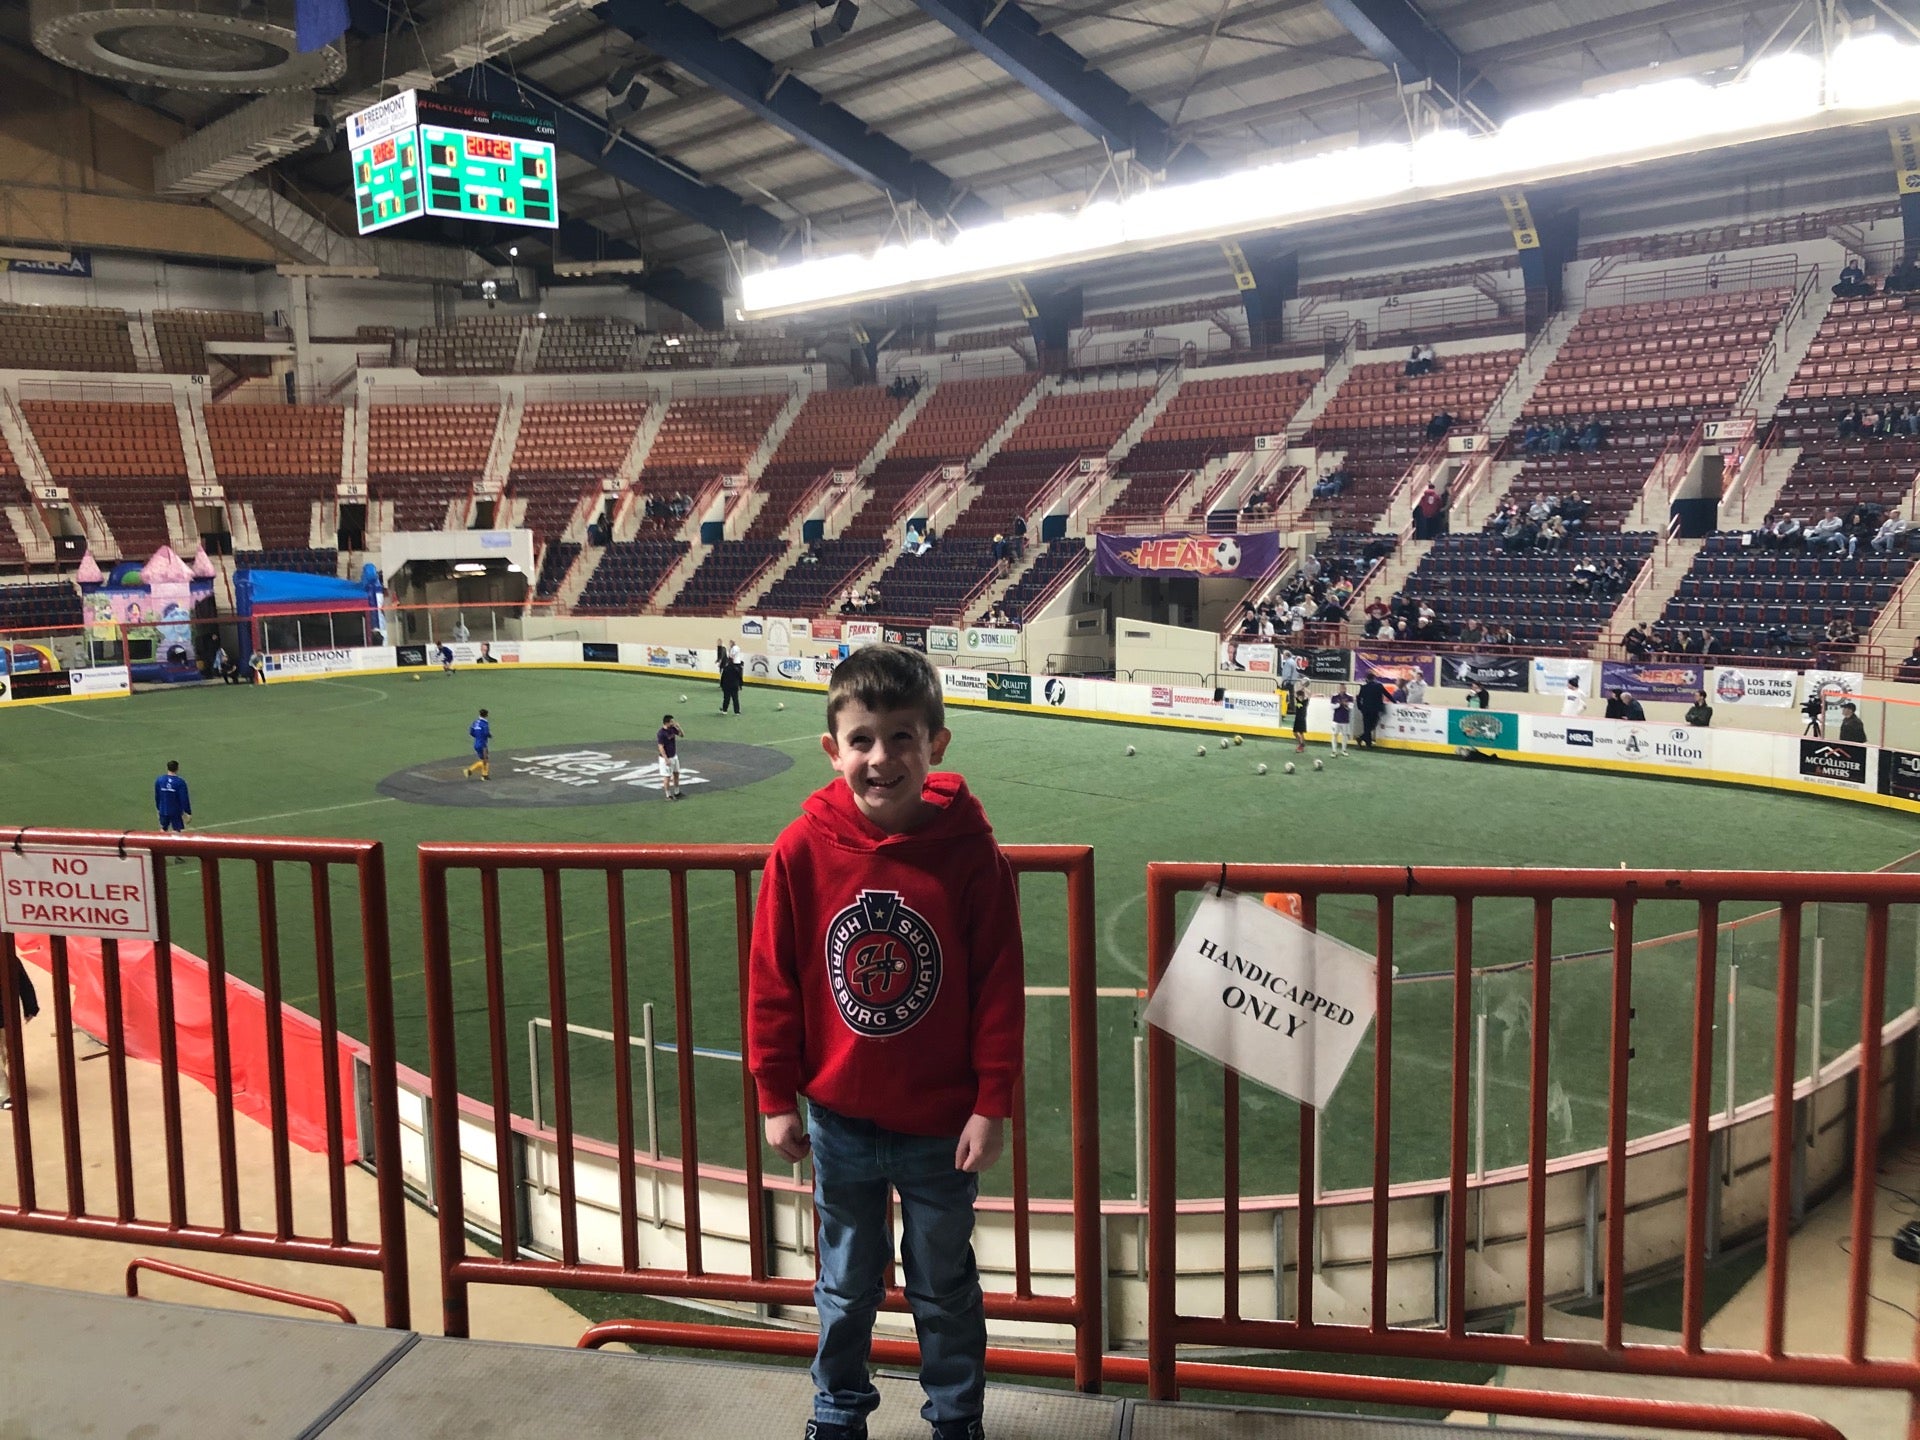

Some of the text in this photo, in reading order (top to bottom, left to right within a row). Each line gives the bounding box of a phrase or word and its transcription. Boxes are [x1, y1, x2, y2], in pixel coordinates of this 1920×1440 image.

[364, 96, 405, 122] FREEDMONT
[466, 136, 512, 160] 20:25
[445, 145, 457, 167] 0
[535, 158, 547, 179] 0
[1385, 297, 1399, 307] 45
[191, 376, 204, 384] 50
[1706, 424, 1718, 437] 17
[1137, 539, 1221, 573] HEAT
[848, 625, 877, 638] FRANK'S
[981, 633, 999, 644] STONE
[999, 634, 1016, 646] ALLEY
[282, 650, 352, 664] FREEDMONT
[783, 660, 801, 671] BAPS
[1477, 668, 1505, 678] mitre
[955, 681, 987, 690] CHIROPRACTIC
[1002, 679, 1028, 690] QUALITY
[1747, 678, 1792, 688] LOS TRES
[1747, 688, 1792, 698] CUBANOS
[1235, 698, 1279, 709] FREEDMONT
[1533, 730, 1565, 740] Explore
[1656, 743, 1702, 759] Hilton
[1822, 767, 1850, 778] MYERS
[52, 858, 88, 876] NO
[8, 879, 141, 902] STROLLER
[21, 903, 129, 925] PARKING
[833, 916, 933, 1026] HARRISBURG SENATORS
[1198, 938, 1355, 1027] HANDICAPPED
[1222, 985, 1307, 1039] ONLY
